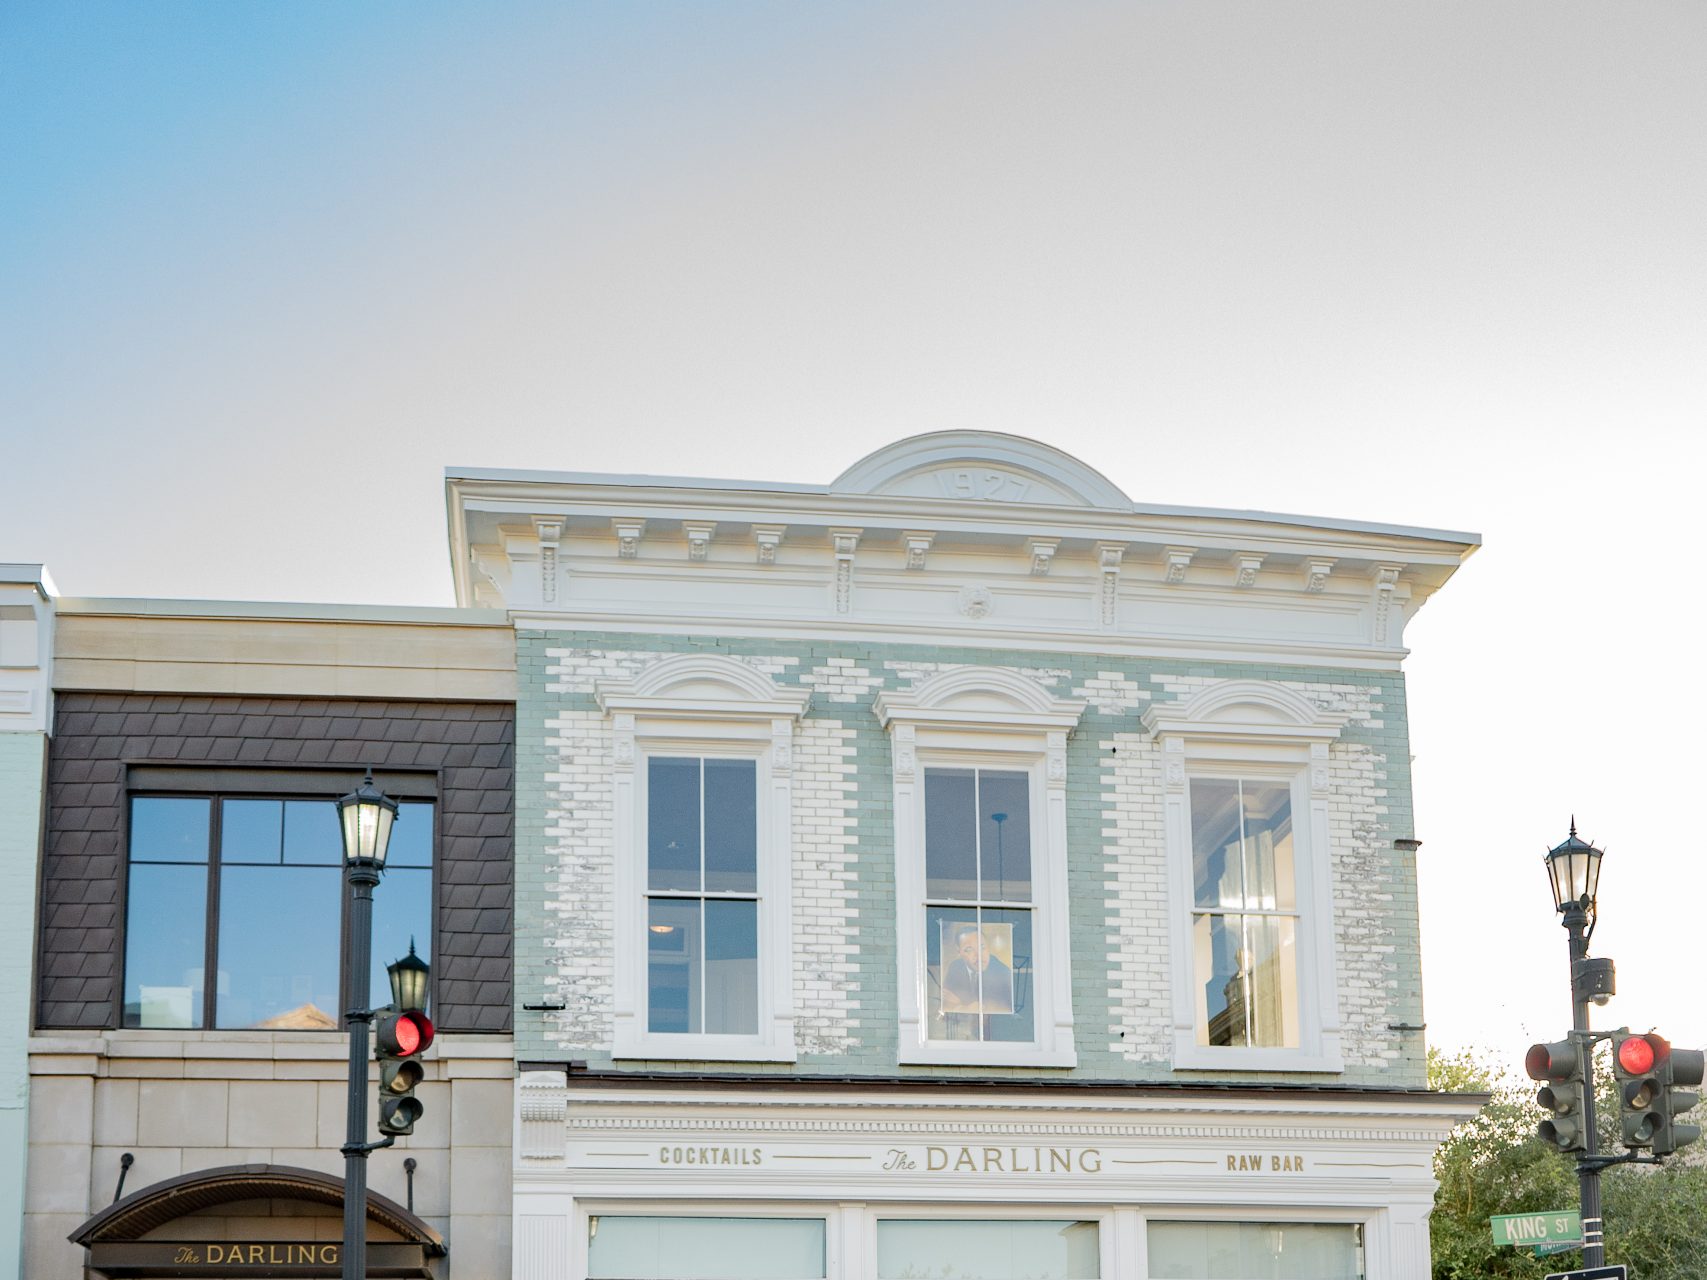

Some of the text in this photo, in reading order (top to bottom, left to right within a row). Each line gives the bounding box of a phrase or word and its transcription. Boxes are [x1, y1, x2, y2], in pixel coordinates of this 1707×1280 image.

[660, 1147, 762, 1165] COCKTAILS
[882, 1146, 1102, 1173] The DARLING
[1227, 1154, 1304, 1172] RAW BAR
[1505, 1216, 1569, 1240] KING ST
[174, 1244, 338, 1264] The DARLING
